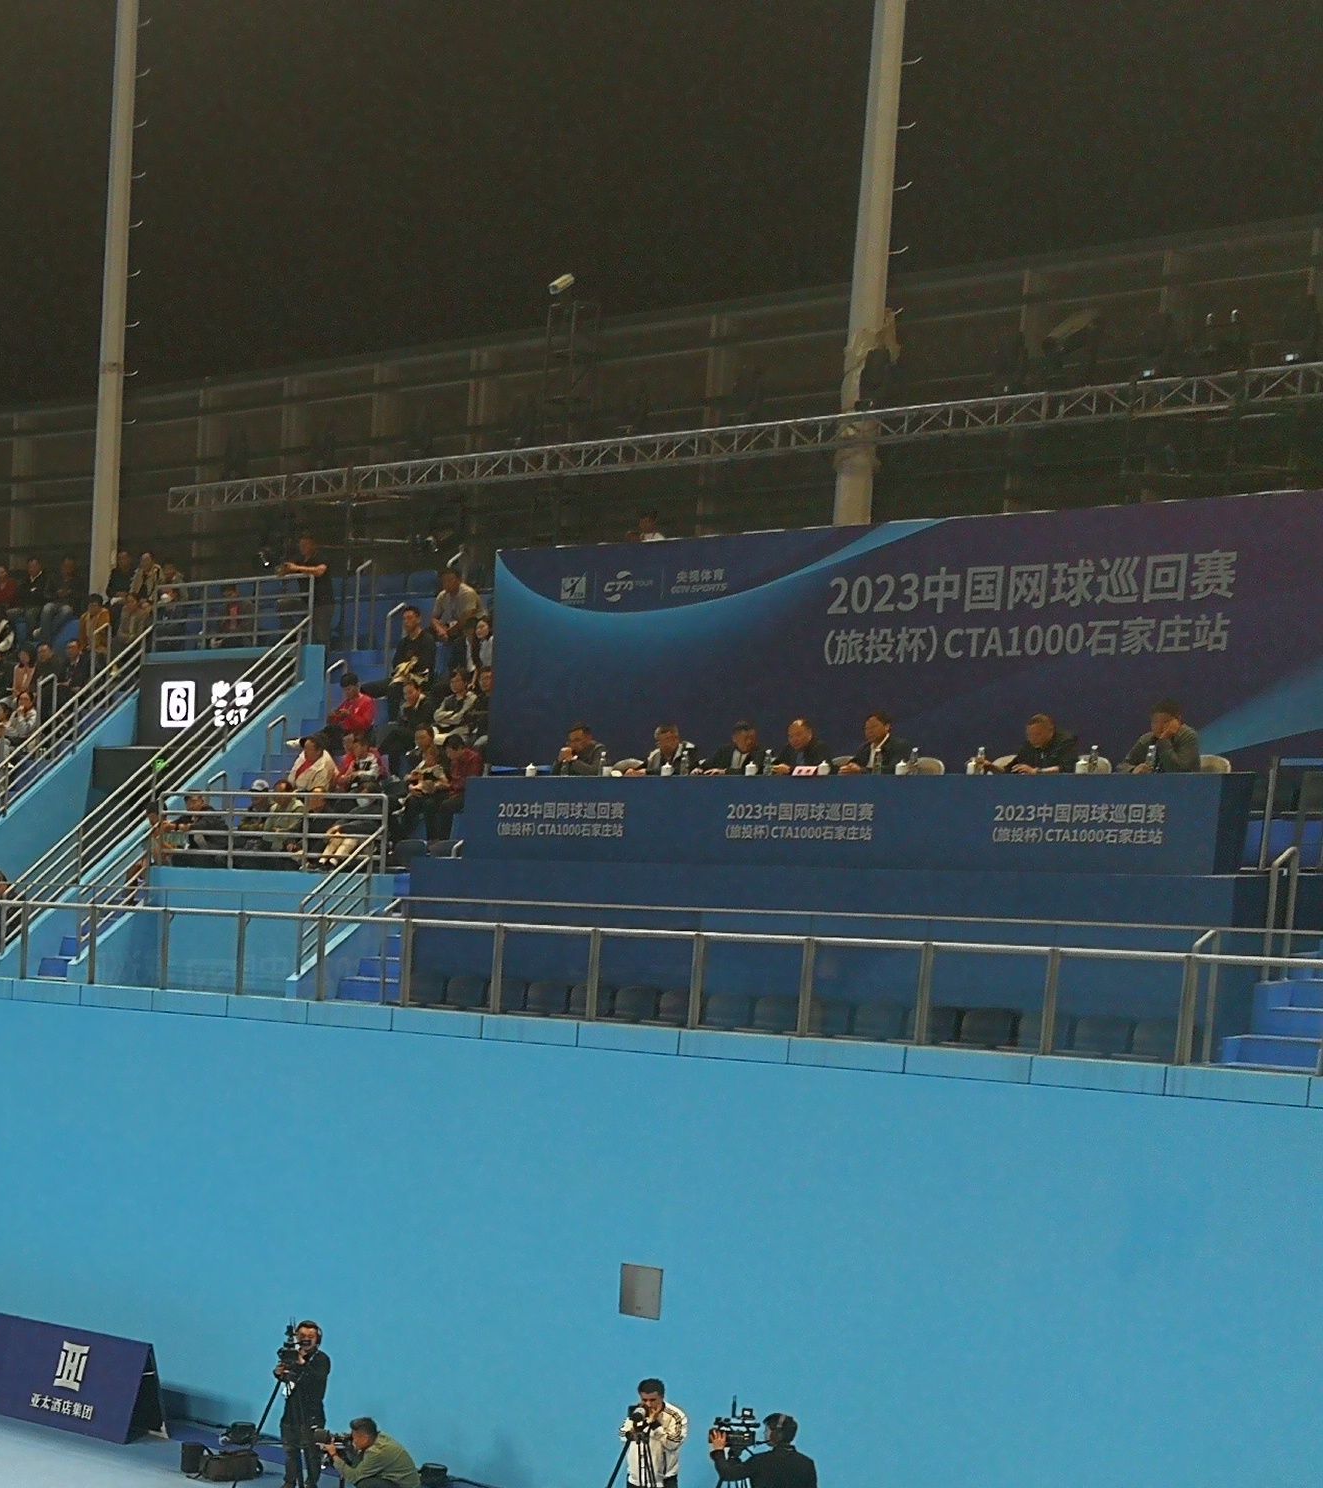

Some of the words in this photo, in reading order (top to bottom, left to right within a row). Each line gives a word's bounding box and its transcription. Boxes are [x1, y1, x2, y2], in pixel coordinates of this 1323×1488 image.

[826, 550, 1237, 617] 2023中国网球巡回赛
[169, 687, 187, 721] 6
[498, 802, 625, 820] 2023中国网球巡回赛
[727, 803, 874, 822] 2023中国网球巡回赛
[994, 803, 1166, 824] 2023中国网球巡回赛
[29, 1392, 94, 1420] 亚太酒店集团
